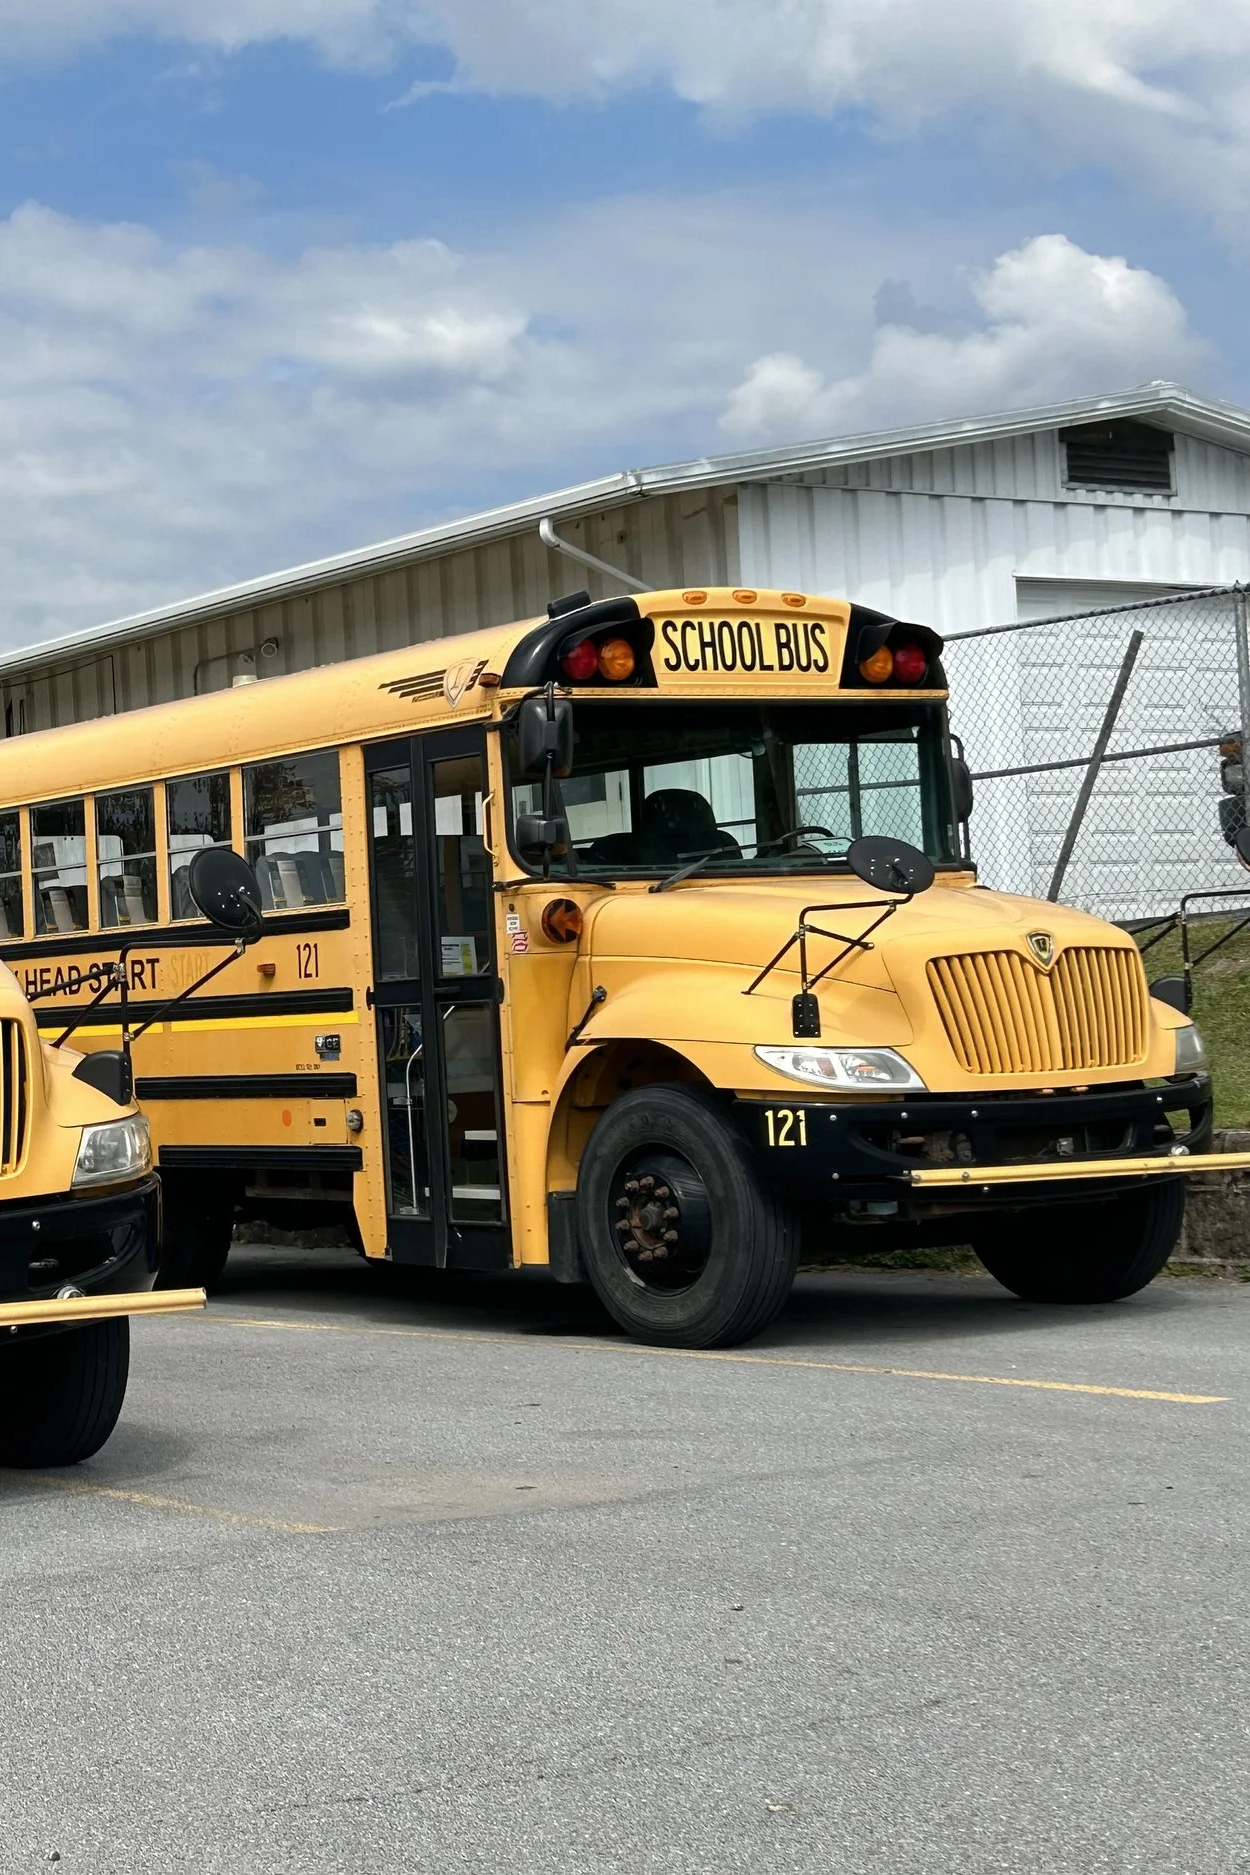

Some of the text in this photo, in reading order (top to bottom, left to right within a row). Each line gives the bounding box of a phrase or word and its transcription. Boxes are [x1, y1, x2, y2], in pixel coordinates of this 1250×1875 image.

[661, 619, 829, 674] SCHOOL BUS
[25, 957, 160, 997] HEAD STRT
[296, 942, 319, 979] 121
[764, 1109, 807, 1146] 121
